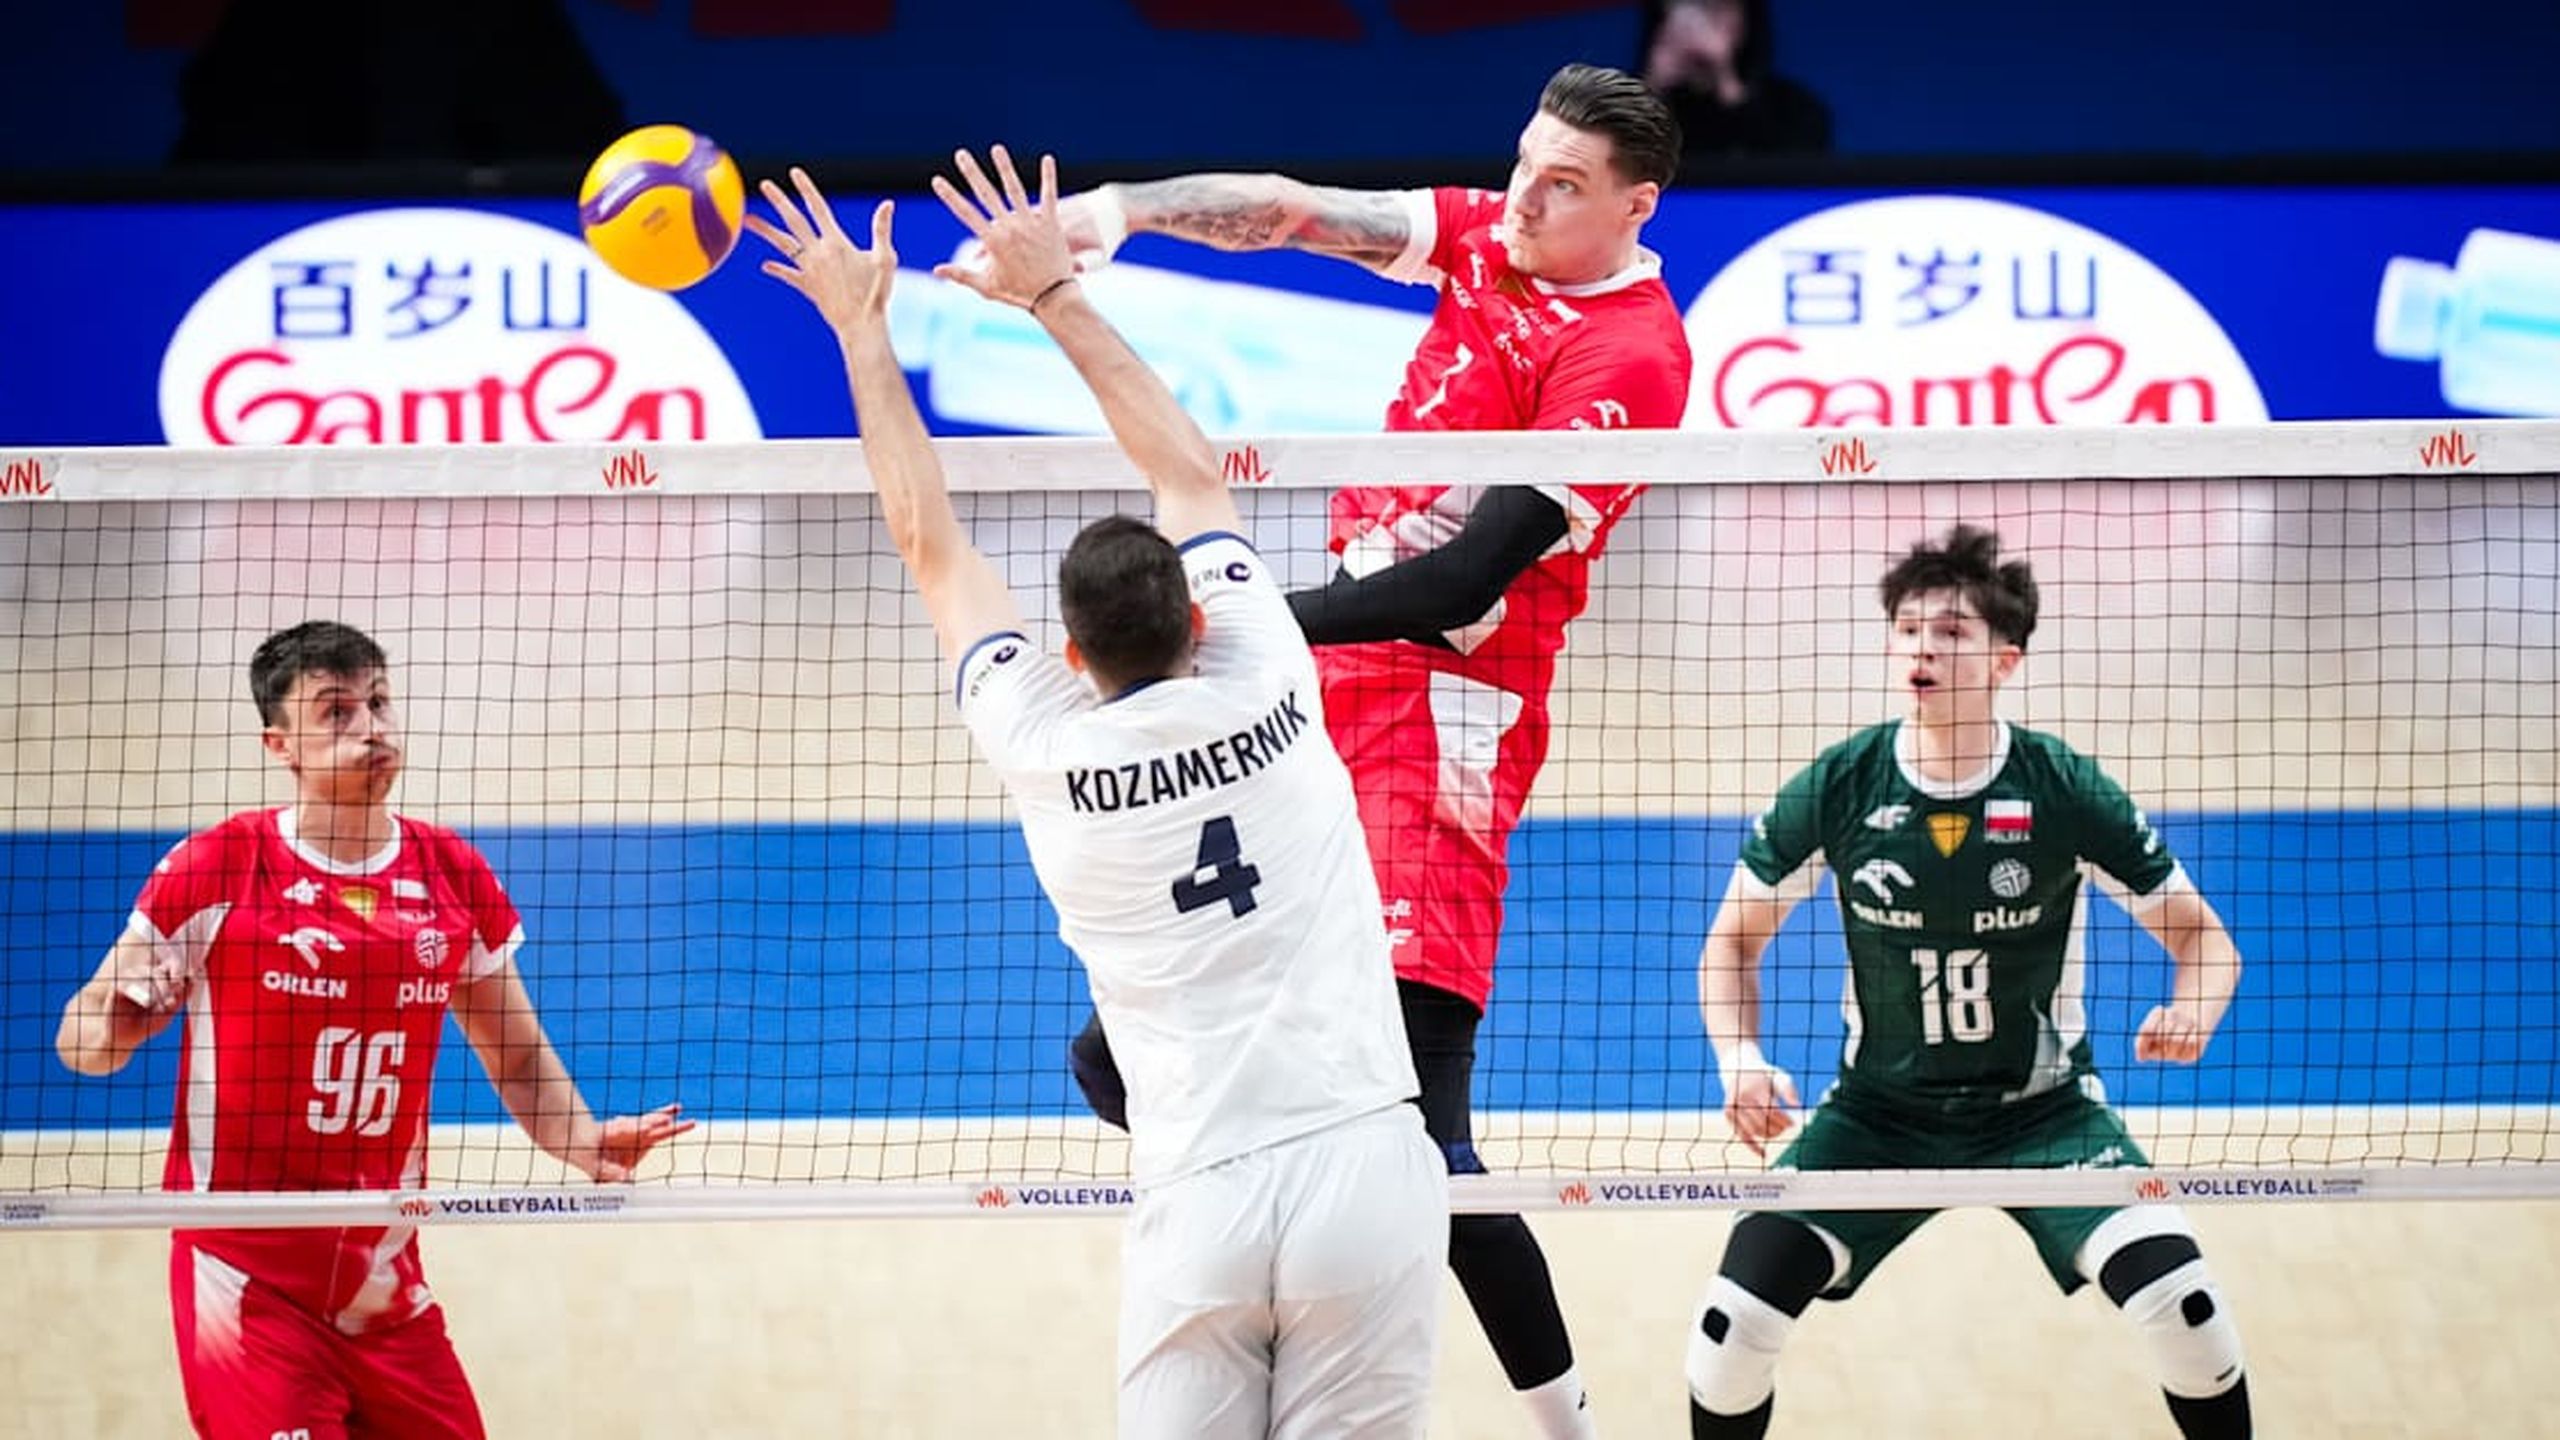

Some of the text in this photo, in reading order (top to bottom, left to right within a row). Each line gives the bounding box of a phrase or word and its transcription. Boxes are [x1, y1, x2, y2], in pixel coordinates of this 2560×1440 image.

[270, 257, 587, 340] 百岁山
[1782, 247, 2097, 327] 百岁山
[1821, 437, 1877, 475] VNL
[2420, 428, 2476, 467] VNL
[0, 458, 52, 495] VNL
[602, 448, 658, 488] VNL
[1066, 691, 1308, 812] KOZAMERNIK
[1172, 815, 1261, 918] 4
[1973, 905, 2042, 933] plus
[263, 970, 347, 998] ORLEN
[396, 977, 450, 1008] plus
[1911, 949, 1994, 1045] 18
[307, 1026, 407, 1137] 96
[441, 1196, 580, 1214] VOLLEYBALL
[976, 1186, 1010, 1208] VNL
[1559, 1181, 1740, 1206] VNL VOLLEYBALL
[2179, 1179, 2317, 1196] VOLLEYBALL
